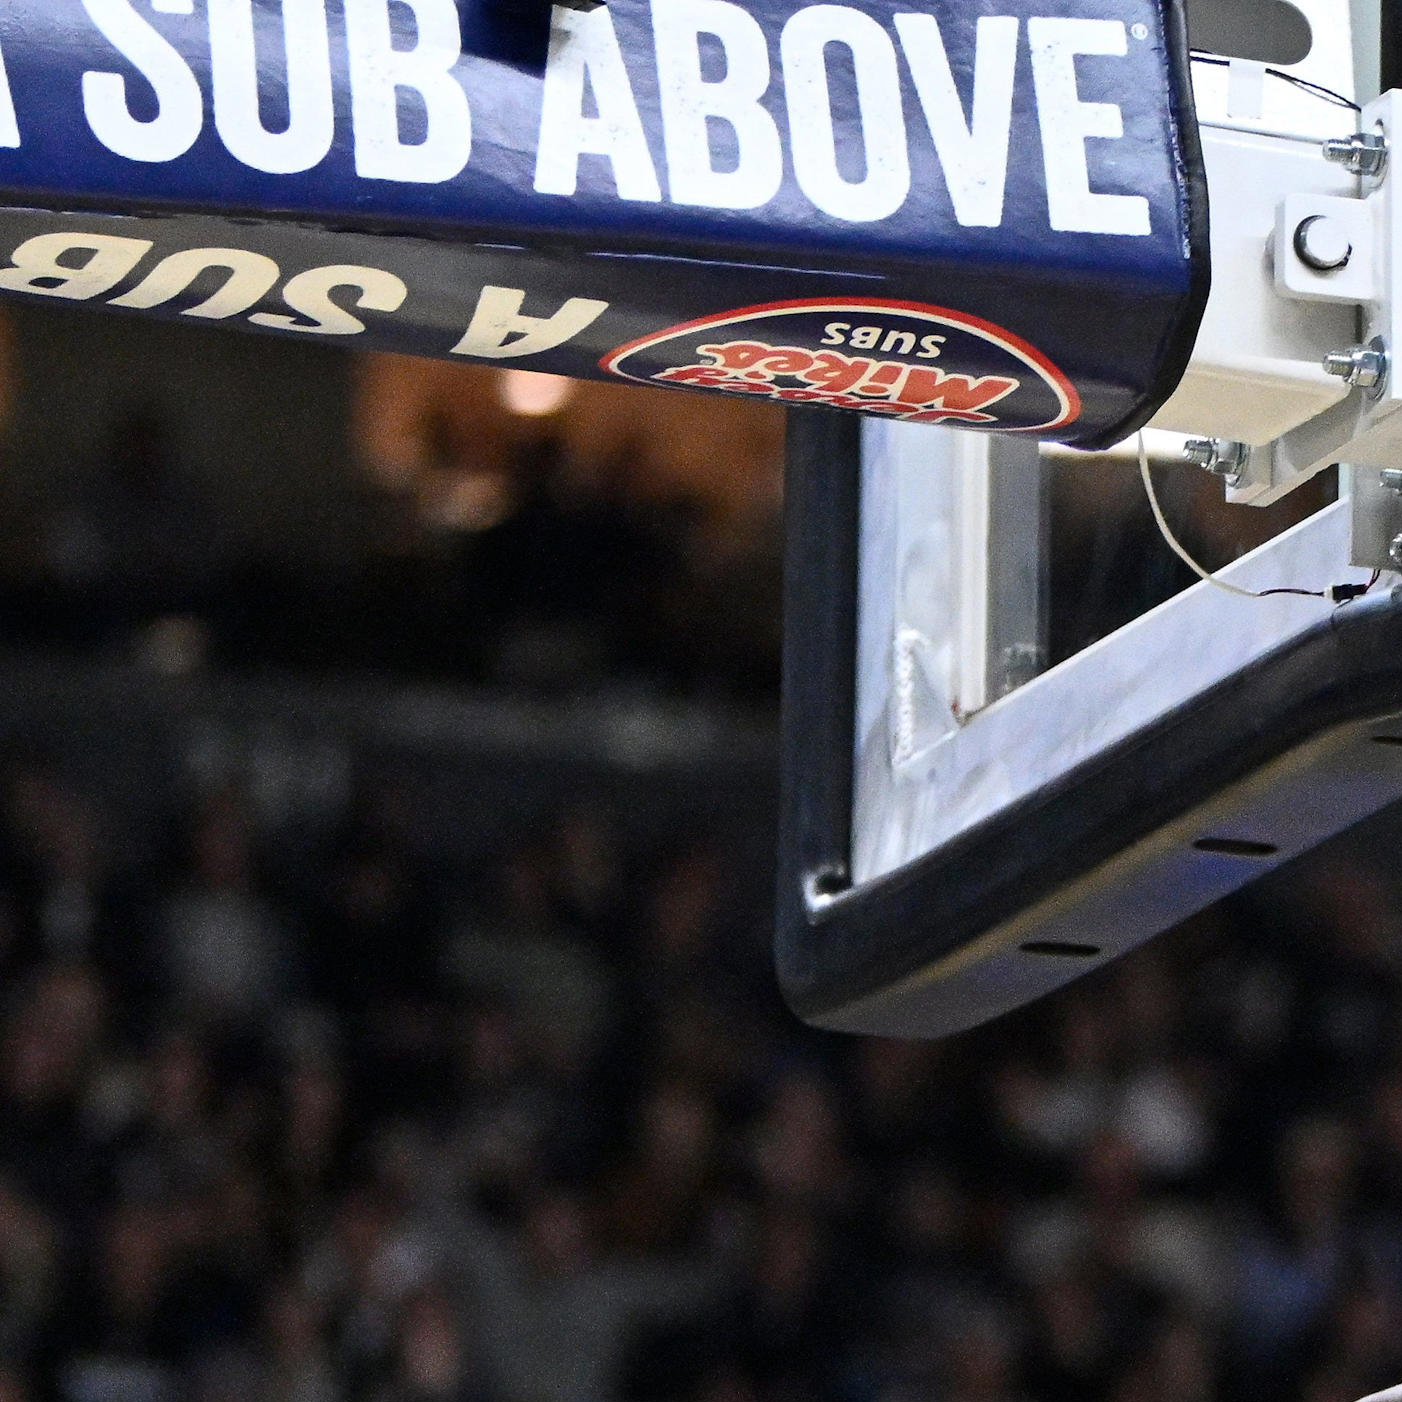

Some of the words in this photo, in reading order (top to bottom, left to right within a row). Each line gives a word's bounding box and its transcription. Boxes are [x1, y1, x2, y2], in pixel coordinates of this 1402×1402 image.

[82, 0, 471, 184] SUB
[533, 0, 1152, 238] ABOVE
[2, 233, 408, 335] SUB
[450, 285, 611, 361] A
[820, 321, 948, 359] SUBS
